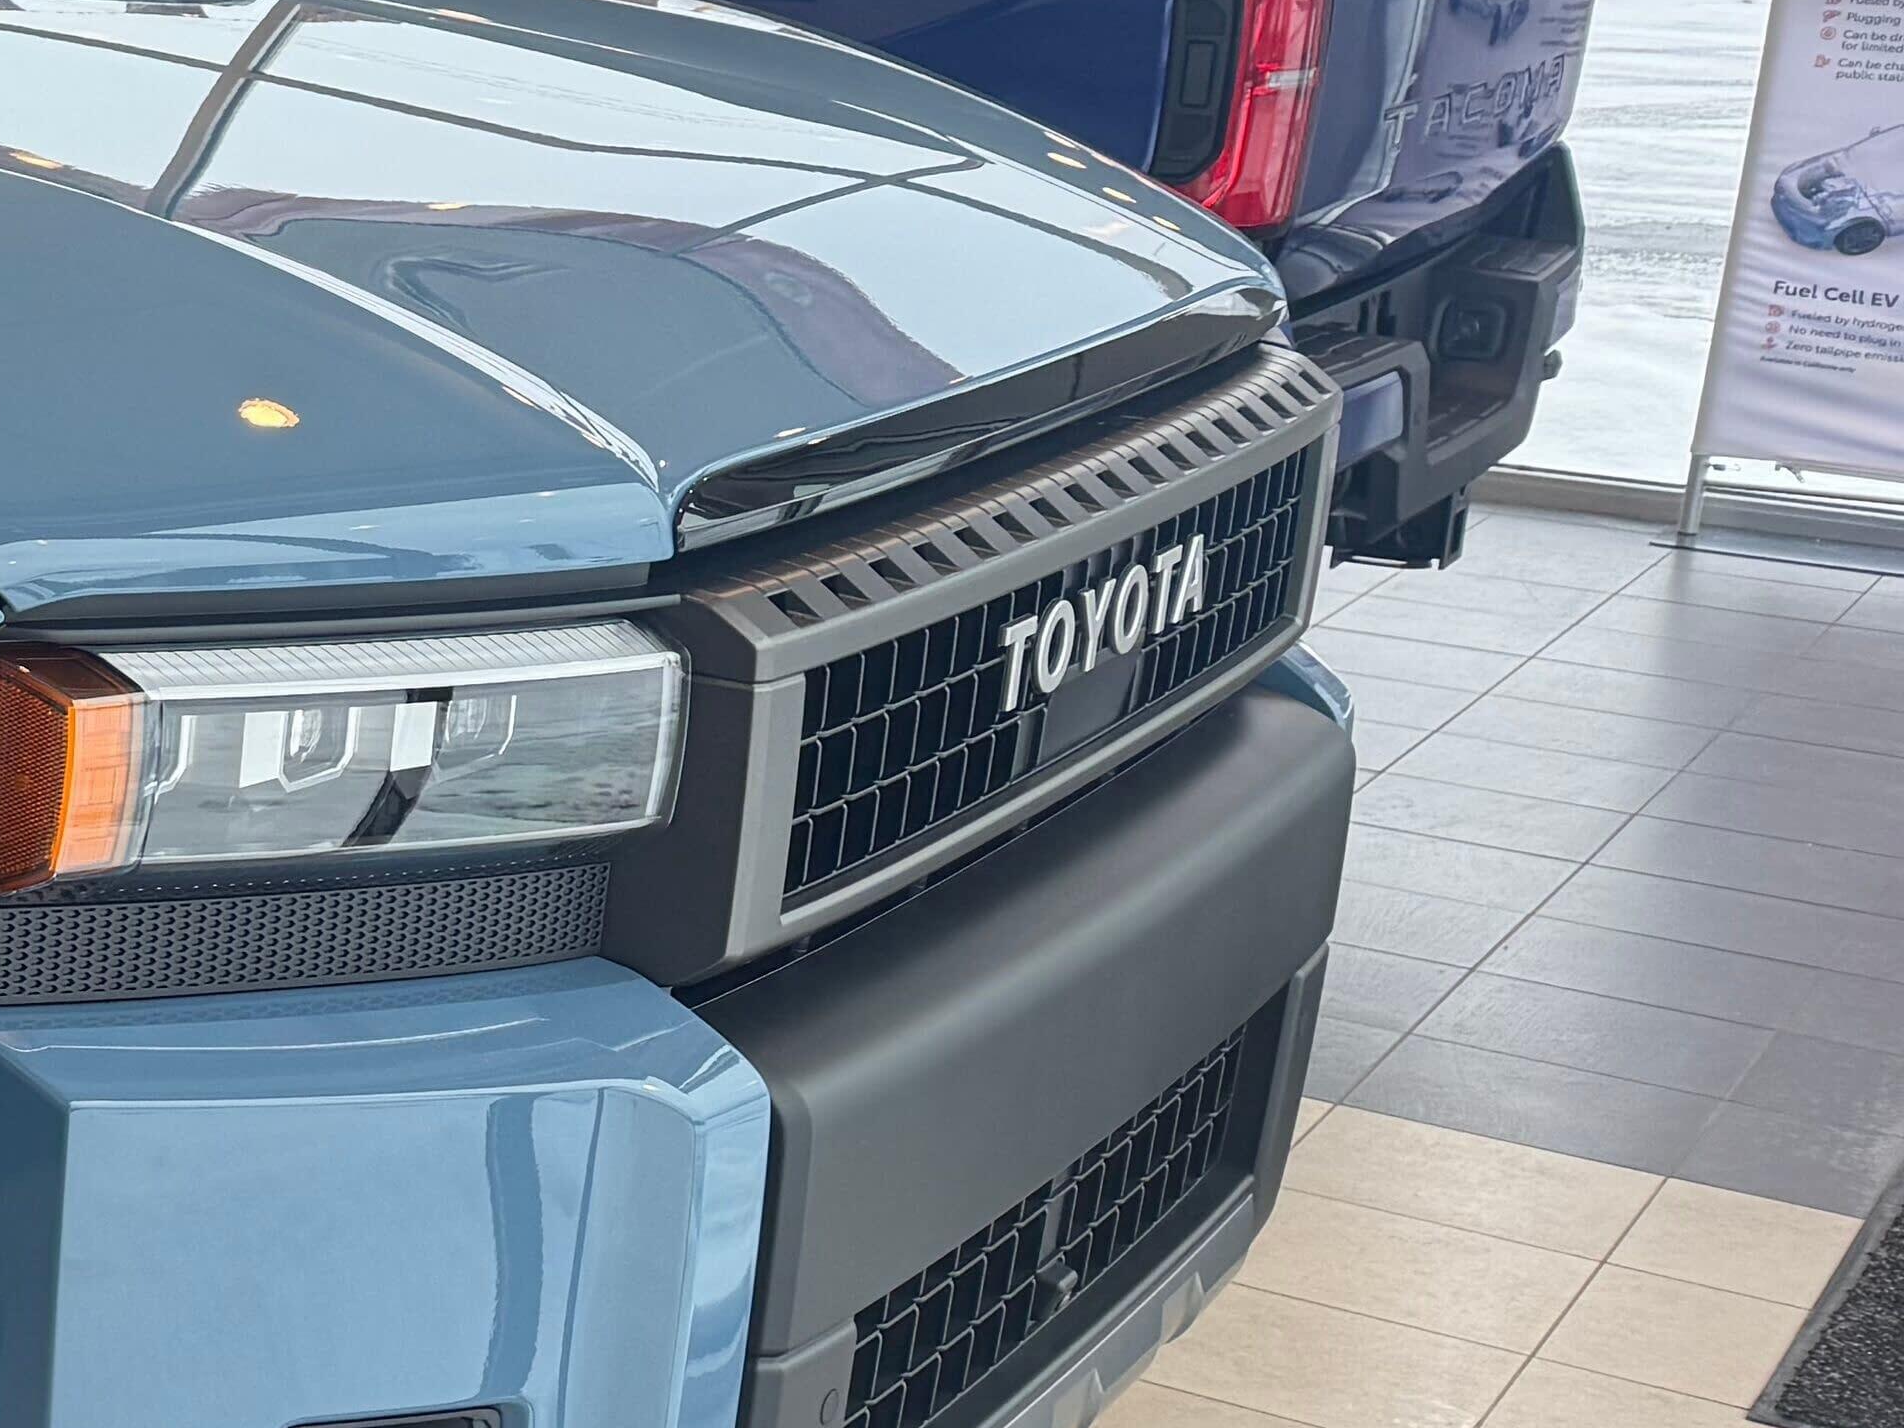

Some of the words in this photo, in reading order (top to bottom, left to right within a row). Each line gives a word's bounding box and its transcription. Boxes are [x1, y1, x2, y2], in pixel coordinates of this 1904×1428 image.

[1846, 11, 1902, 26] Plugging
[1843, 29, 1868, 40] Can
[1871, 30, 1887, 41] be
[1841, 41, 1858, 51] for
[1861, 42, 1904, 53] limited
[1837, 57, 1863, 68] Can
[1865, 58, 1882, 69] be
[1835, 71, 1875, 82] public
[1383, 52, 1565, 150] TACOMA
[1773, 280, 1818, 299] Fuel
[1824, 287, 1865, 305] Cell
[1871, 292, 1900, 308] EV
[1791, 309, 1832, 323] Fueled
[1834, 315, 1850, 327] by
[1788, 324, 1807, 335] No
[1810, 329, 1841, 339] need
[1844, 332, 1856, 341] to
[1858, 335, 1887, 347] plug
[1889, 338, 1902, 347] in
[1785, 340, 1813, 352] Zero
[1815, 345, 1862, 358] tailpipe
[999, 533, 1206, 713] TOYOTA
